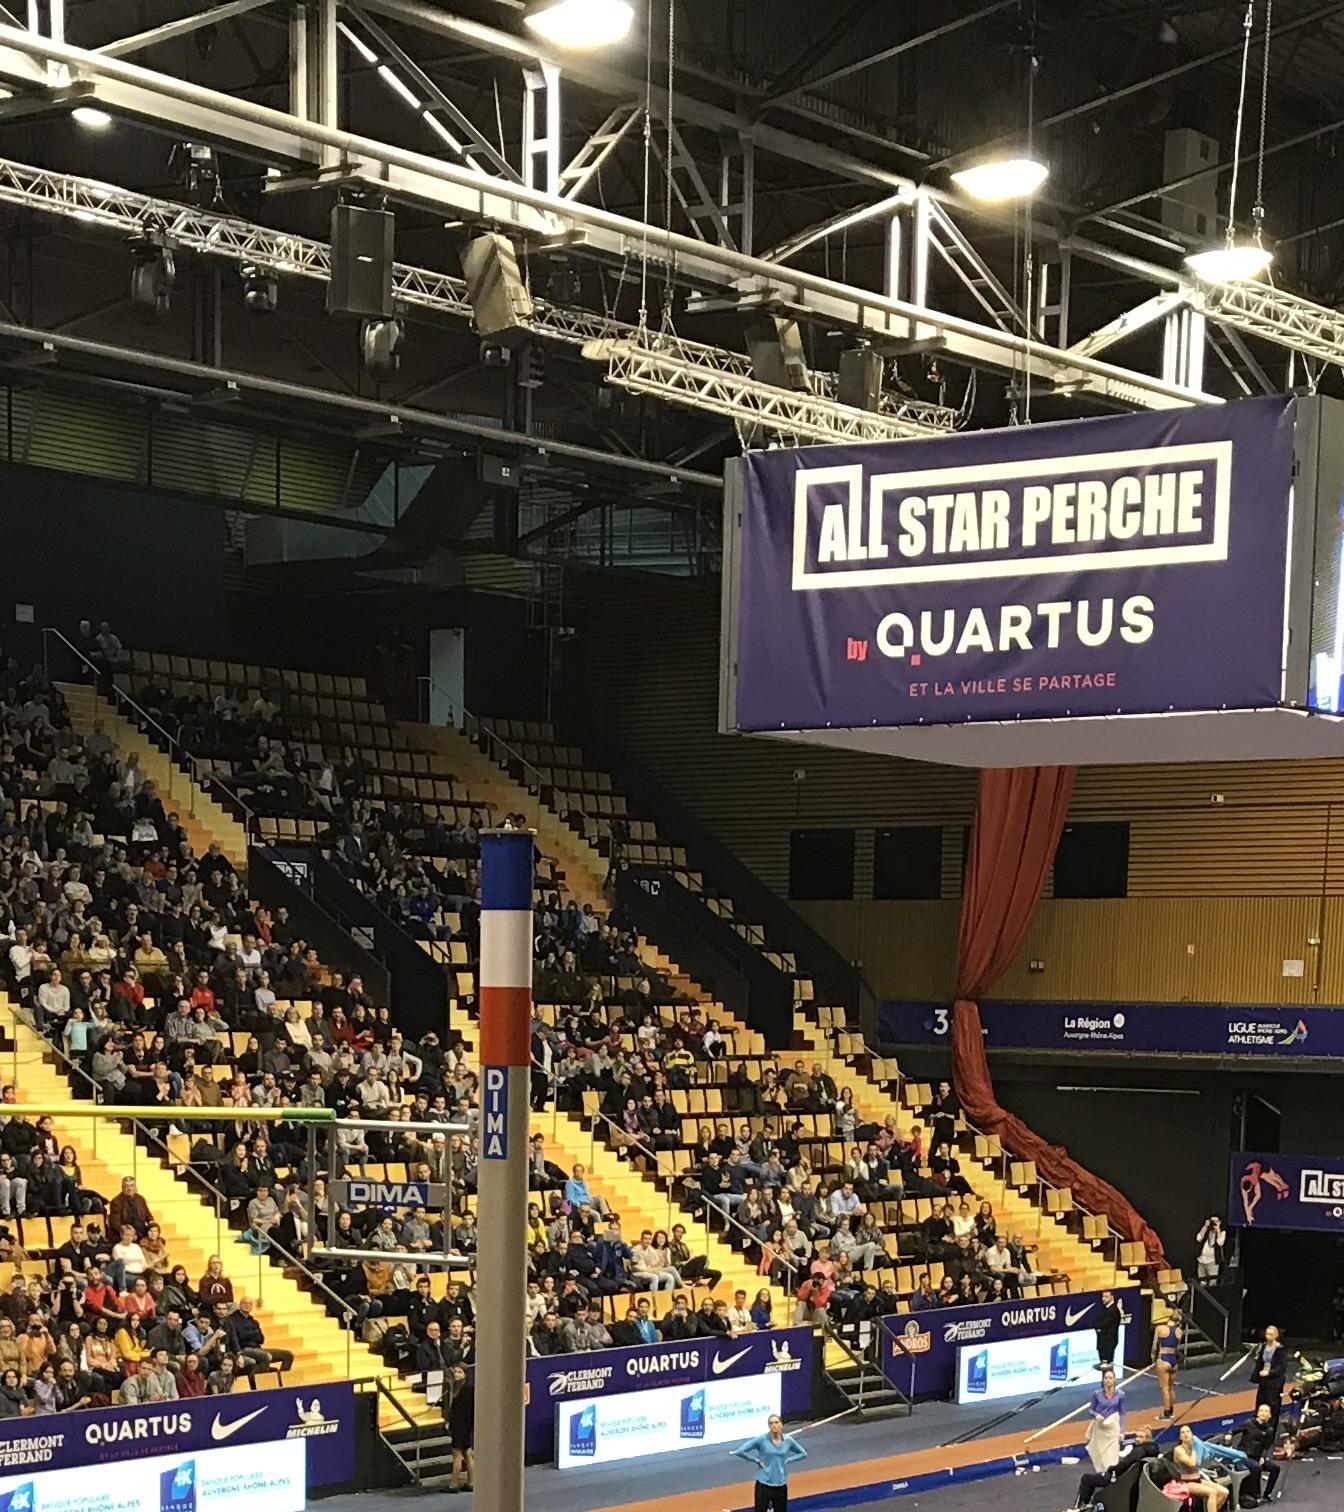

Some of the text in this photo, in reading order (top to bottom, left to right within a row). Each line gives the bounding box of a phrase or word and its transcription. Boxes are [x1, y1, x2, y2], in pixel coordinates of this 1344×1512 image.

[818, 470, 1204, 563] ALL STAR PERCHE
[847, 595, 1155, 662] by QUARTUS
[909, 672, 1117, 698] ET LA VILLE SE PARTAGE
[934, 1009, 949, 1035] 3
[1064, 1016, 1111, 1030] La Région
[1228, 1022, 1256, 1033] LIGUE
[487, 1069, 504, 1156] DIMA
[350, 1183, 424, 1204] DIMA
[1308, 1177, 1330, 1196] ALL
[1002, 1306, 1057, 1327] QUARTUS
[567, 1366, 613, 1382] CLERMONT
[626, 1351, 700, 1376] QUARTUS
[764, 1360, 802, 1374] MICHELIN
[567, 1378, 605, 1392] FERRAND
[85, 1413, 192, 1445] QUARTUS
[286, 1423, 339, 1439] MICHELIN
